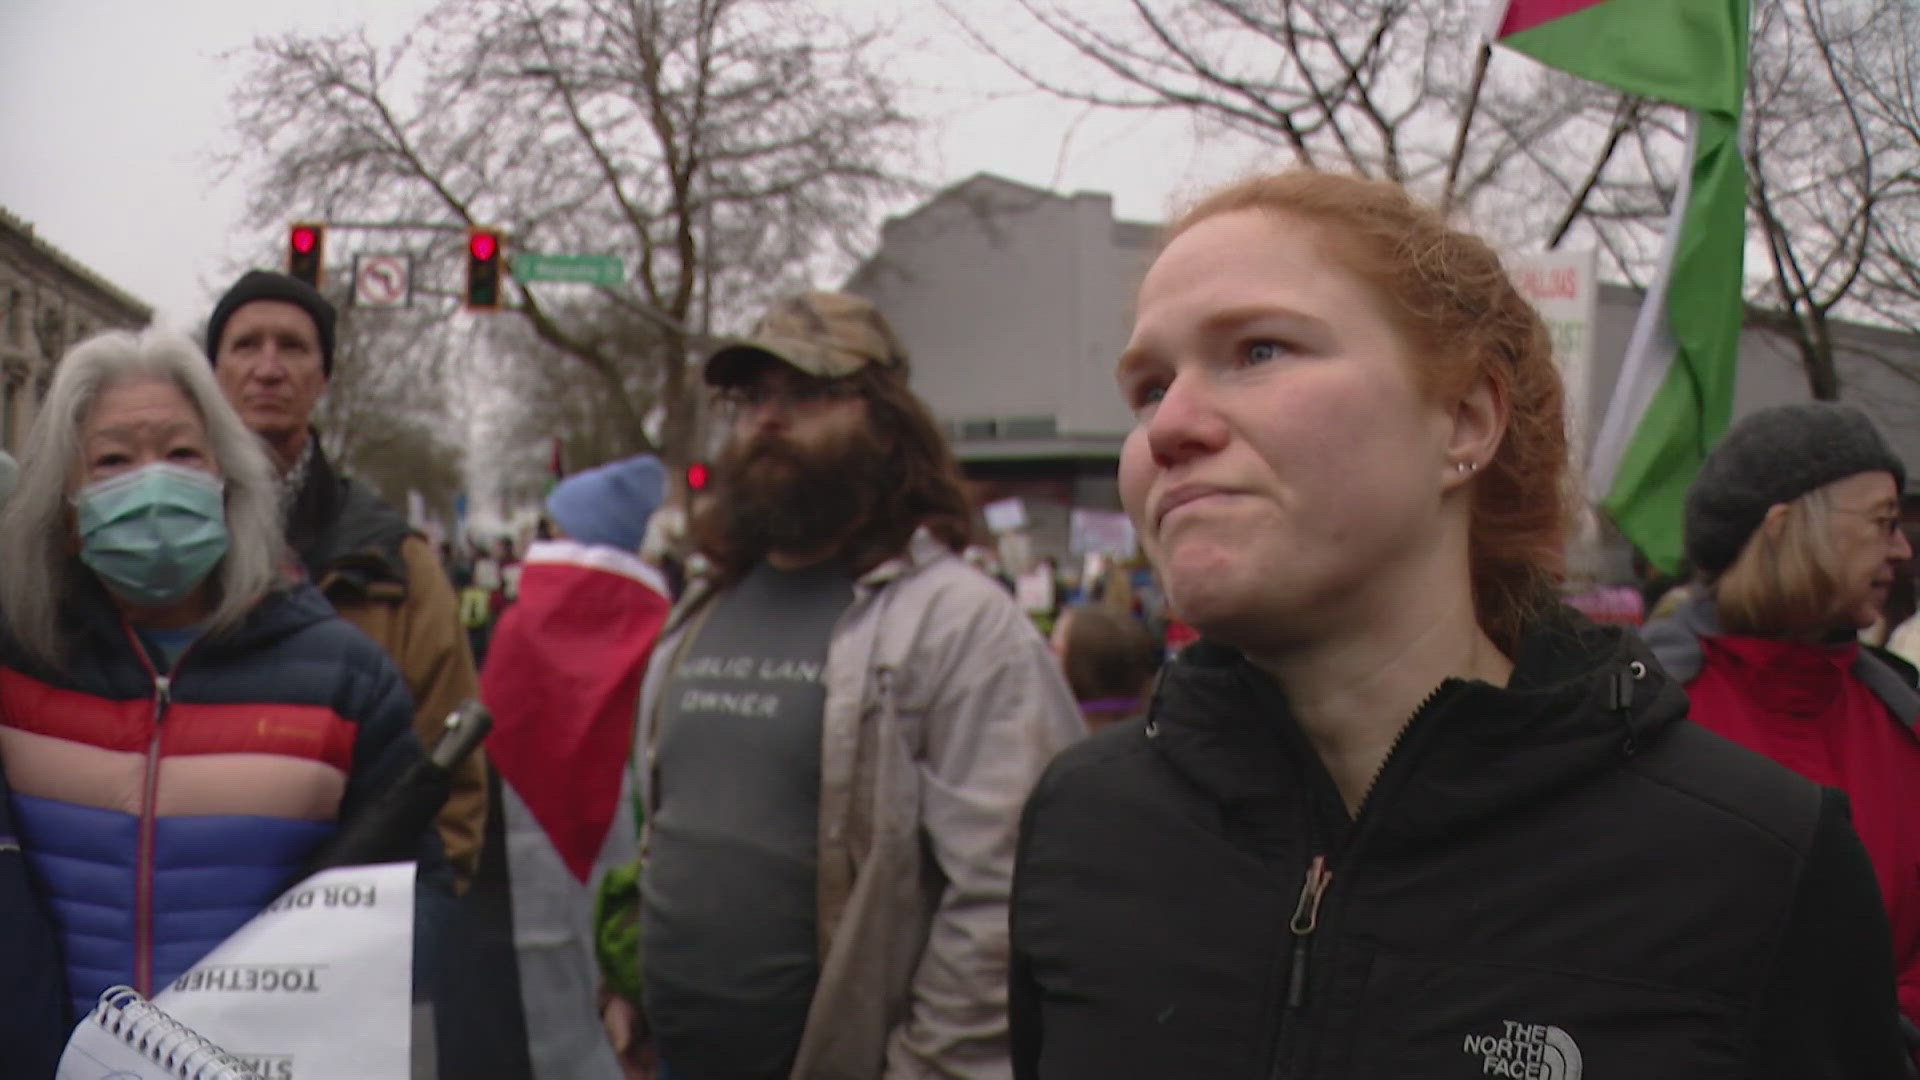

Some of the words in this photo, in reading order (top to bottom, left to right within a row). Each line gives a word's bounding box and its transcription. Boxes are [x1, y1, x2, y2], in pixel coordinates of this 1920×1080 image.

[681, 688, 780, 718] OWNER
[325, 886, 378, 909] FOR
[173, 969, 320, 993] TOGETHER
[1503, 1019, 1547, 1044] THE
[1463, 1033, 1543, 1064] NORTH
[1483, 1055, 1541, 1080] FACE
